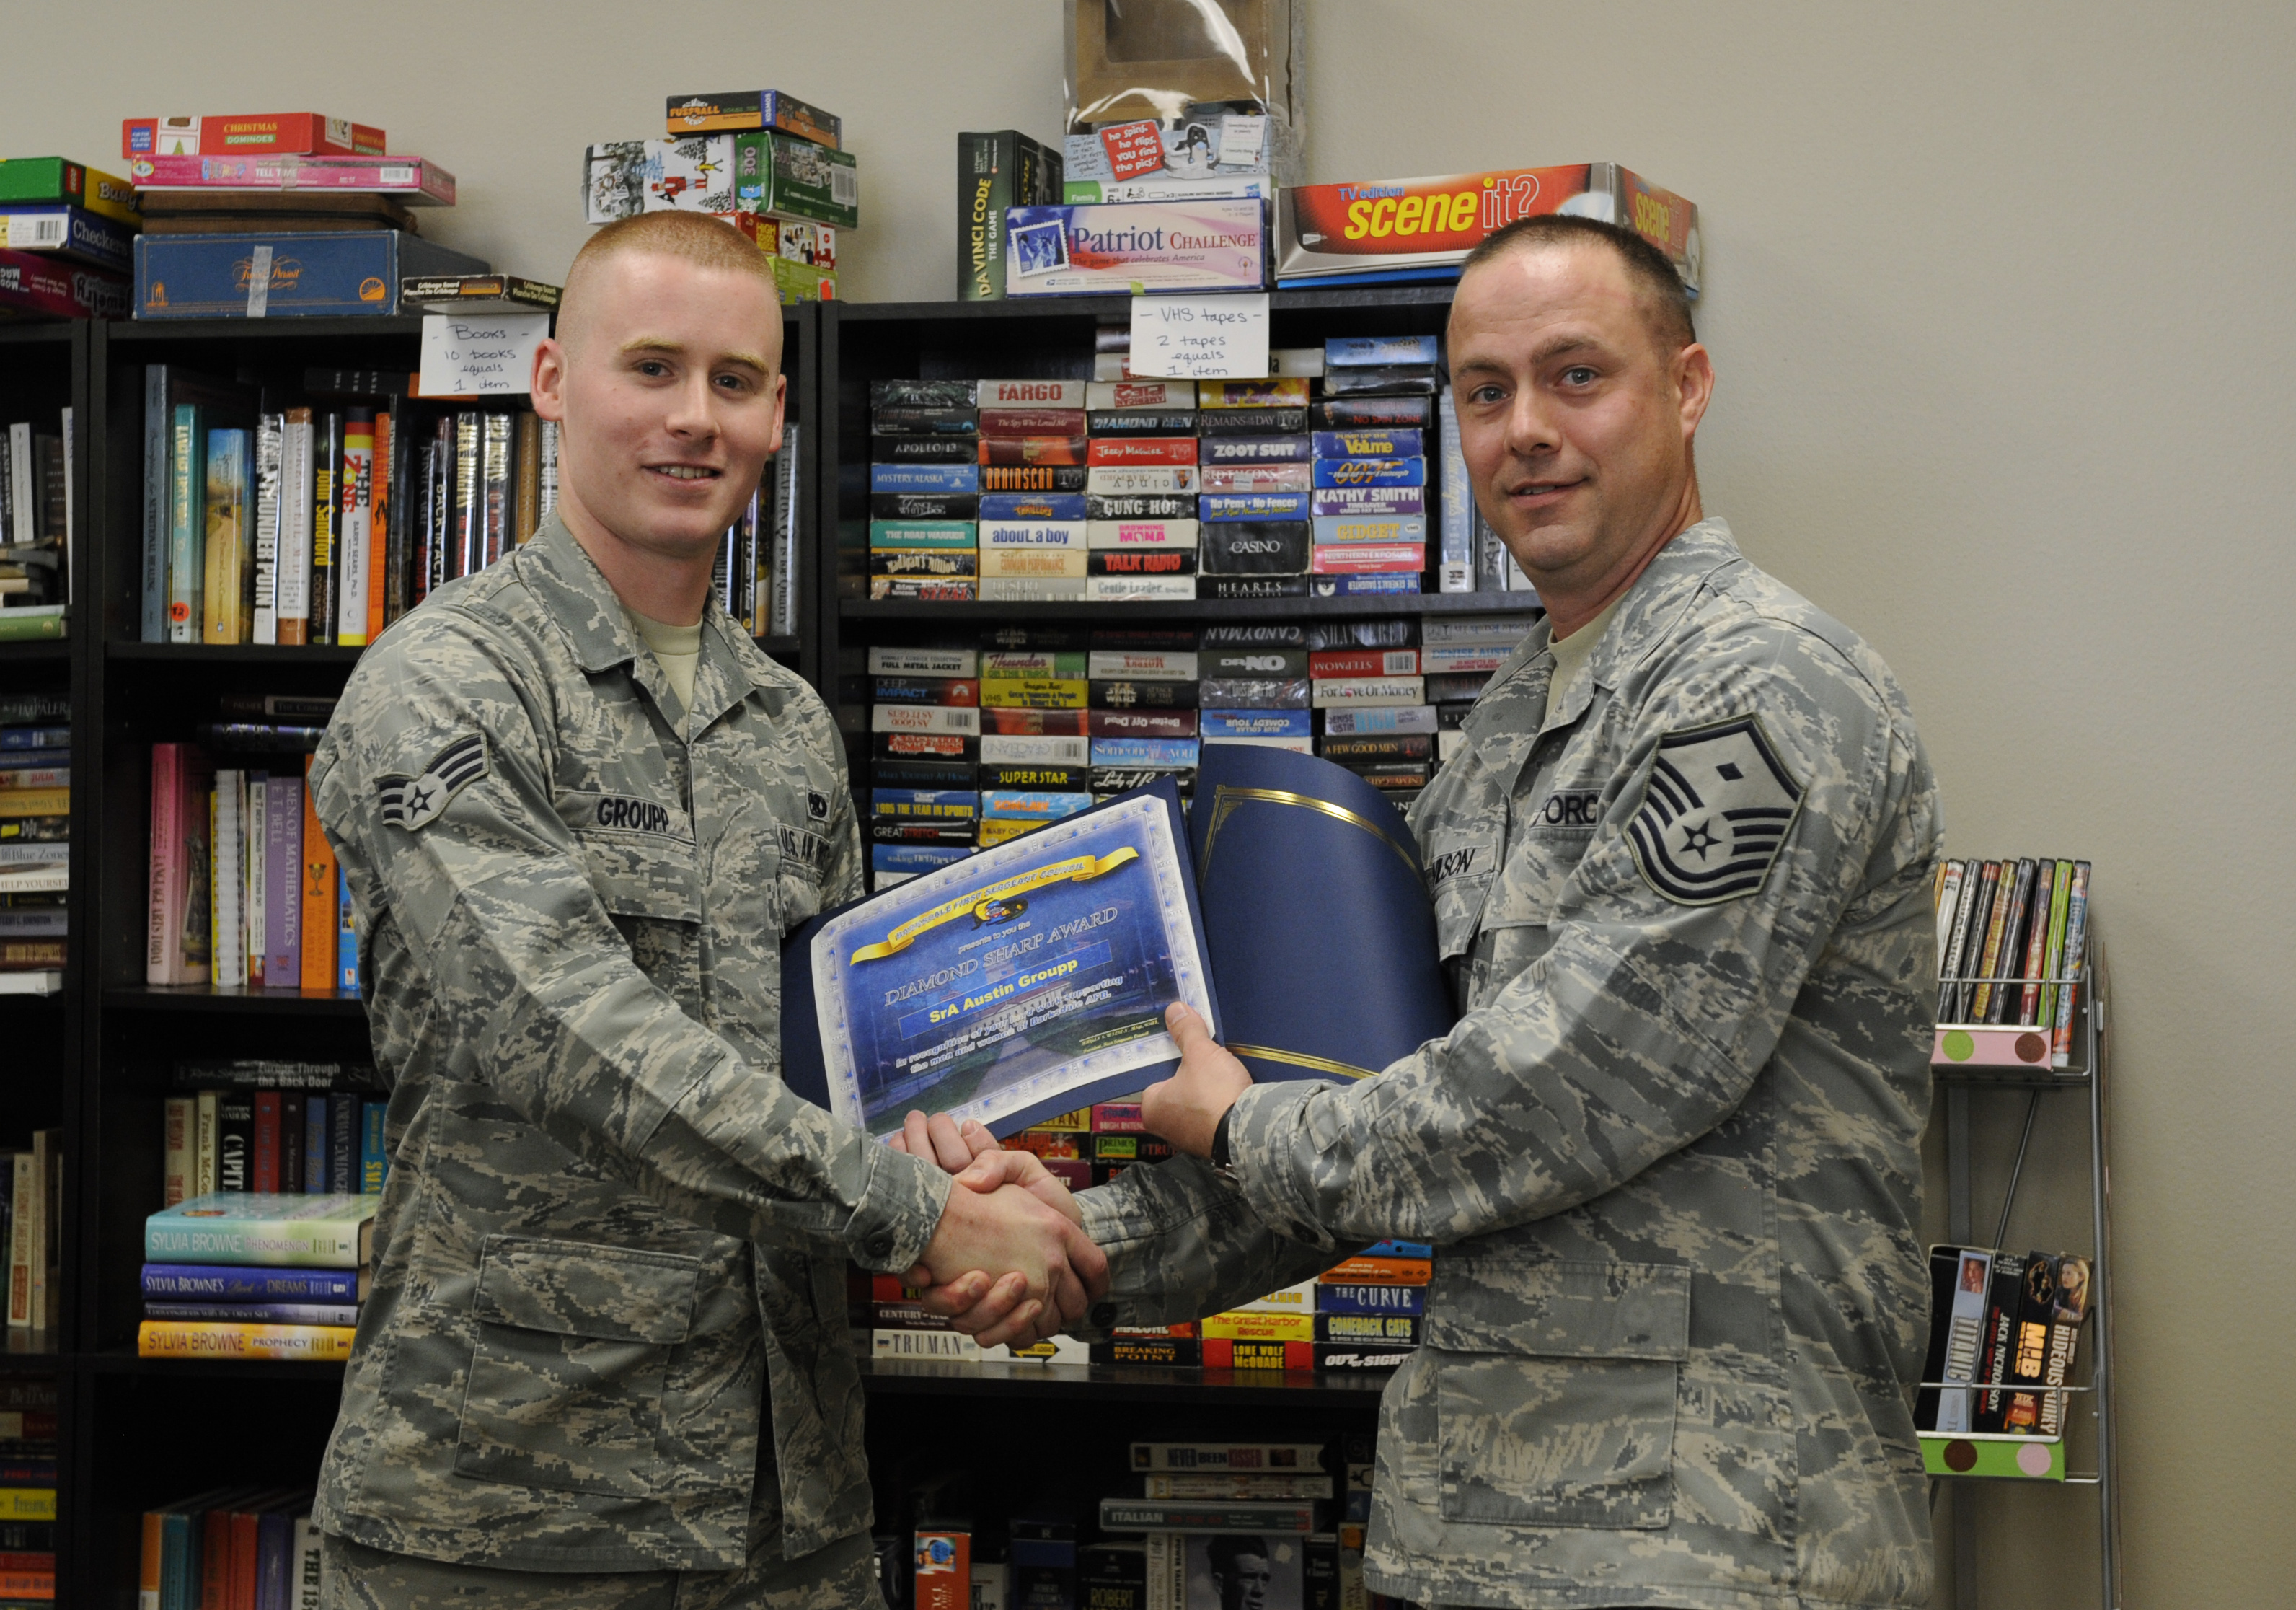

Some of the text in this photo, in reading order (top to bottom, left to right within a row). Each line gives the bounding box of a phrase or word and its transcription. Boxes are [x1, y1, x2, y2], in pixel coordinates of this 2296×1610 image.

[224, 123, 278, 133] CHRISTMAS
[226, 135, 275, 144] DOMINOES
[1108, 132, 1121, 141] he
[1119, 140, 1132, 149] he
[744, 147, 756, 176] 300
[1116, 146, 1158, 162] YOU find
[1115, 156, 1158, 172] the pics!
[255, 168, 275, 177] TELL
[99, 182, 137, 211] Busy
[1338, 185, 1404, 201] TV edition
[1344, 175, 1540, 239] scene it?
[1635, 196, 1669, 243] scene
[74, 220, 128, 252] Checkers
[757, 224, 776, 234] HIGH
[972, 178, 992, 297] DA VINCI CODE
[1072, 226, 1256, 253] Patriot CHALLENGE
[1074, 253, 1205, 268] The game that celebrates America
[1161, 307, 1248, 325] VHS tapes
[446, 325, 506, 340] Books
[1157, 335, 1226, 348] 2 tapes
[445, 349, 516, 360] 10 books
[1171, 351, 1224, 364] equals
[460, 364, 503, 374] equals
[1166, 365, 1228, 376] 1 item
[454, 376, 510, 392] 1 item
[998, 384, 1062, 401] FARGO
[1093, 417, 1192, 428] DIAMOND MEN
[1201, 415, 1247, 426] REMAINS
[1214, 444, 1296, 457] ZOOT SUIT
[1345, 439, 1393, 454] Volume
[356, 459, 371, 508] THE
[986, 468, 1053, 490] BRAINSCAN
[1316, 488, 1419, 503] KATHY SMITH
[436, 484, 445, 527] BACK
[1103, 499, 1177, 514] GUNG HO!
[314, 469, 336, 566] John Sandford
[886, 530, 966, 540] THE ROAD WARRIOR
[992, 528, 1069, 545] about a boy
[1120, 531, 1165, 542] MONA
[1337, 522, 1400, 540] GIDGET
[1231, 542, 1281, 553] CASINO
[1104, 553, 1182, 572] TALK RADIO
[1219, 581, 1281, 592] HEARTS
[1206, 627, 1301, 640] CANDYMAN
[989, 654, 1047, 668] Thunder
[1432, 649, 1474, 659] DENISE
[1315, 661, 1372, 671] STEPMOM
[876, 688, 927, 698] IMPACT
[1320, 686, 1418, 700] For Love Or Money
[19, 703, 66, 717] IMPALER
[30, 773, 55, 784] JULIA
[999, 771, 1068, 784] SUPER STAR
[597, 798, 669, 832] GROUPP
[283, 786, 296, 947] MEN OF MATHEMATICS
[896, 863, 1084, 939] BARKSDALE FIRST SERGEANT COUNCIL
[884, 907, 1118, 1006] DIAMOND SHARP AWARD
[930, 959, 1078, 1023] SrA Austin Groupp
[896, 1057, 907, 1068] In
[909, 1034, 968, 1063] recognition
[971, 1030, 981, 1040] of
[984, 1020, 1008, 1037] your
[1036, 998, 1063, 1014] work
[1065, 975, 1123, 1003] supporting
[911, 990, 1111, 1073] the men and women of Barksdale AFB.
[201, 1112, 212, 1152] Frank
[151, 1232, 309, 1253] SYLVIA BROWNE PHENOMENON
[146, 1276, 308, 1293] SYLVIA BROWNE'S DREAMS
[1335, 1287, 1412, 1308] THE CURVE
[1212, 1316, 1302, 1326] The Great Harbor
[1328, 1318, 1413, 1336] COMEBACK CATS
[1997, 1313, 2010, 1341] JACK
[1237, 1327, 1275, 1337] Rescue
[149, 1334, 308, 1352] SYLVIA BROWNE PROPHECY
[893, 1334, 961, 1355] TRUMAN
[1233, 1345, 1284, 1356] LONE WOLF
[1947, 1317, 1979, 1381] TITANIC
[2047, 1324, 2070, 1386] HIDEOUS
[1234, 1358, 1284, 1369] McQUADE
[1988, 1342, 2006, 1412] NICHOLSON
[1111, 1512, 1163, 1522] ITALIAN
